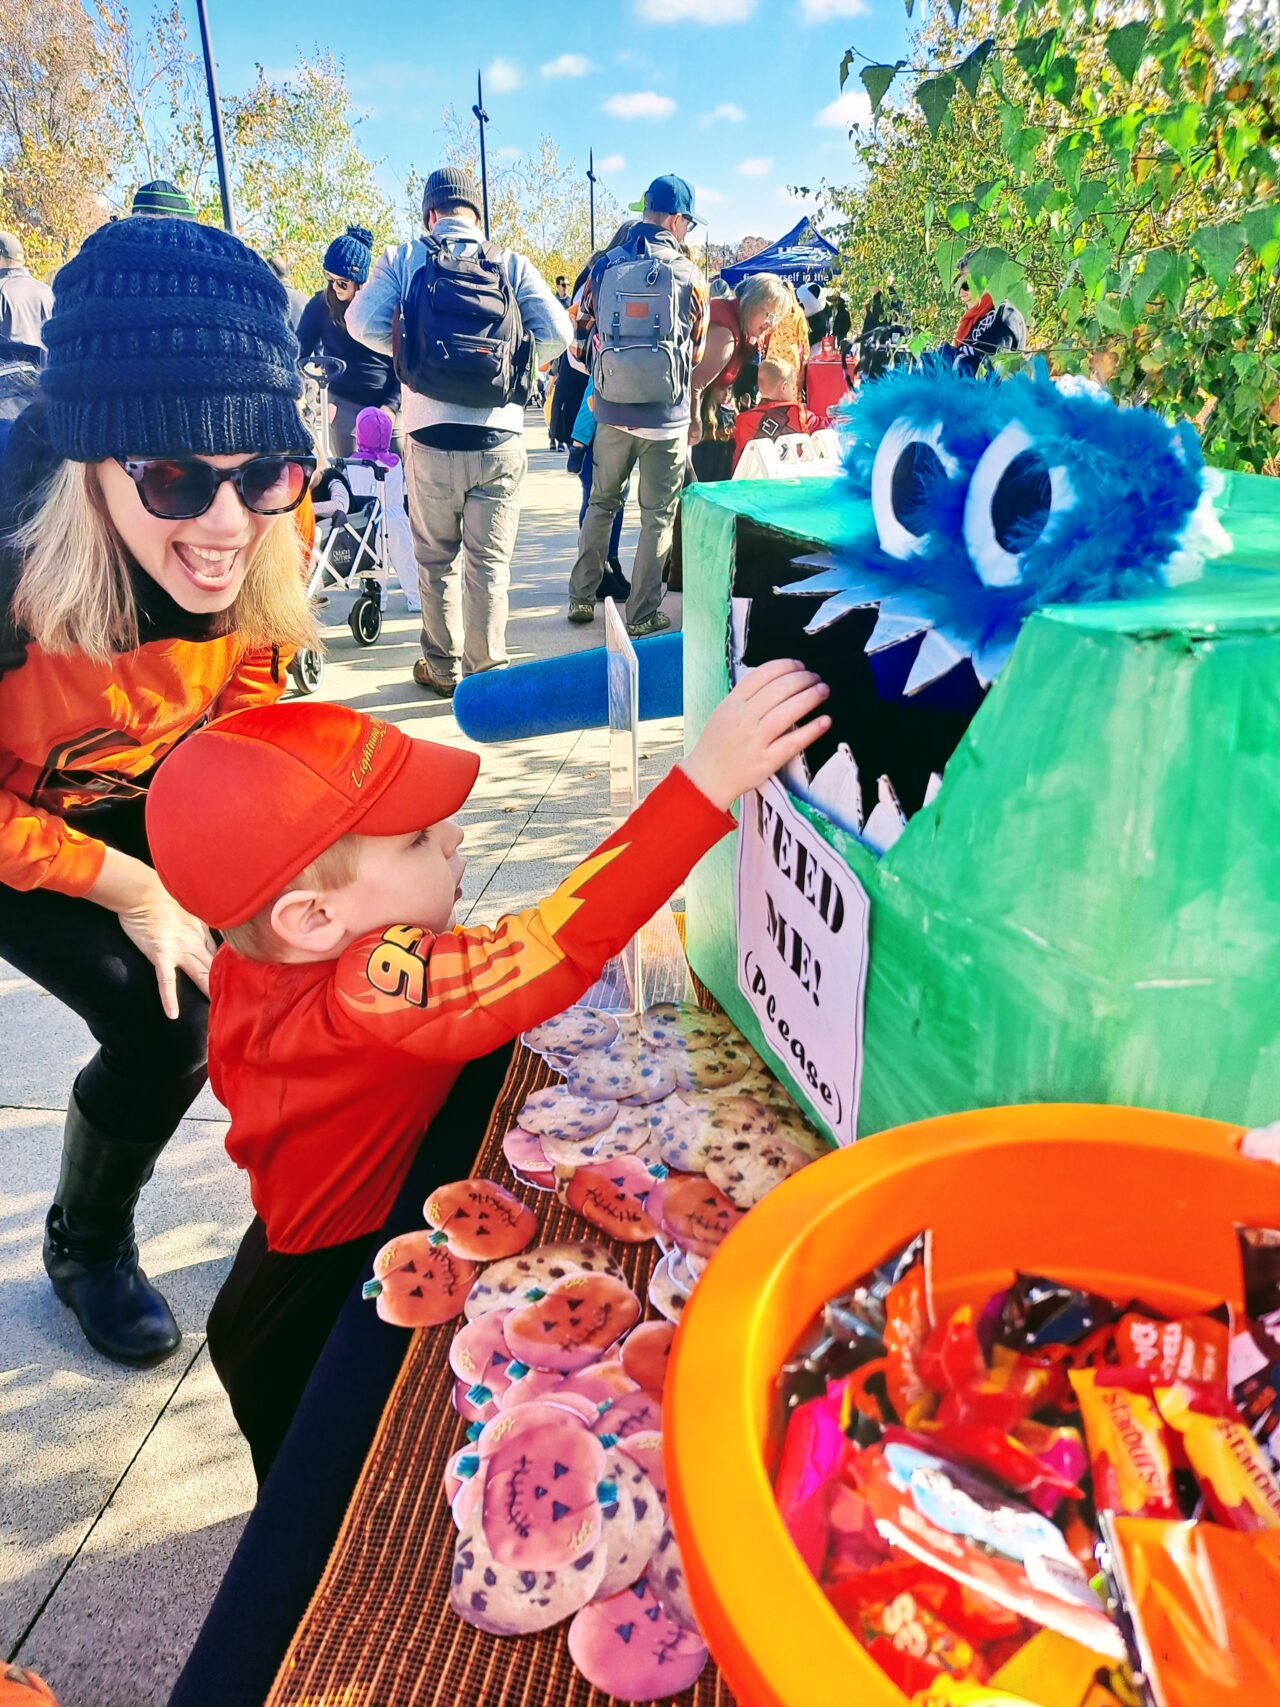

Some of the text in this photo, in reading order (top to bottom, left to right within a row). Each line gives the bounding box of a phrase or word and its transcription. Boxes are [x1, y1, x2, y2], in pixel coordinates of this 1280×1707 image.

[779, 272, 800, 282] rself
[814, 272, 829, 282] the
[351, 727, 381, 788] Lightning
[755, 787, 844, 934] FEED
[366, 924, 437, 1009] 95
[766, 889, 821, 1007] ME!
[745, 951, 842, 1124] (please)
